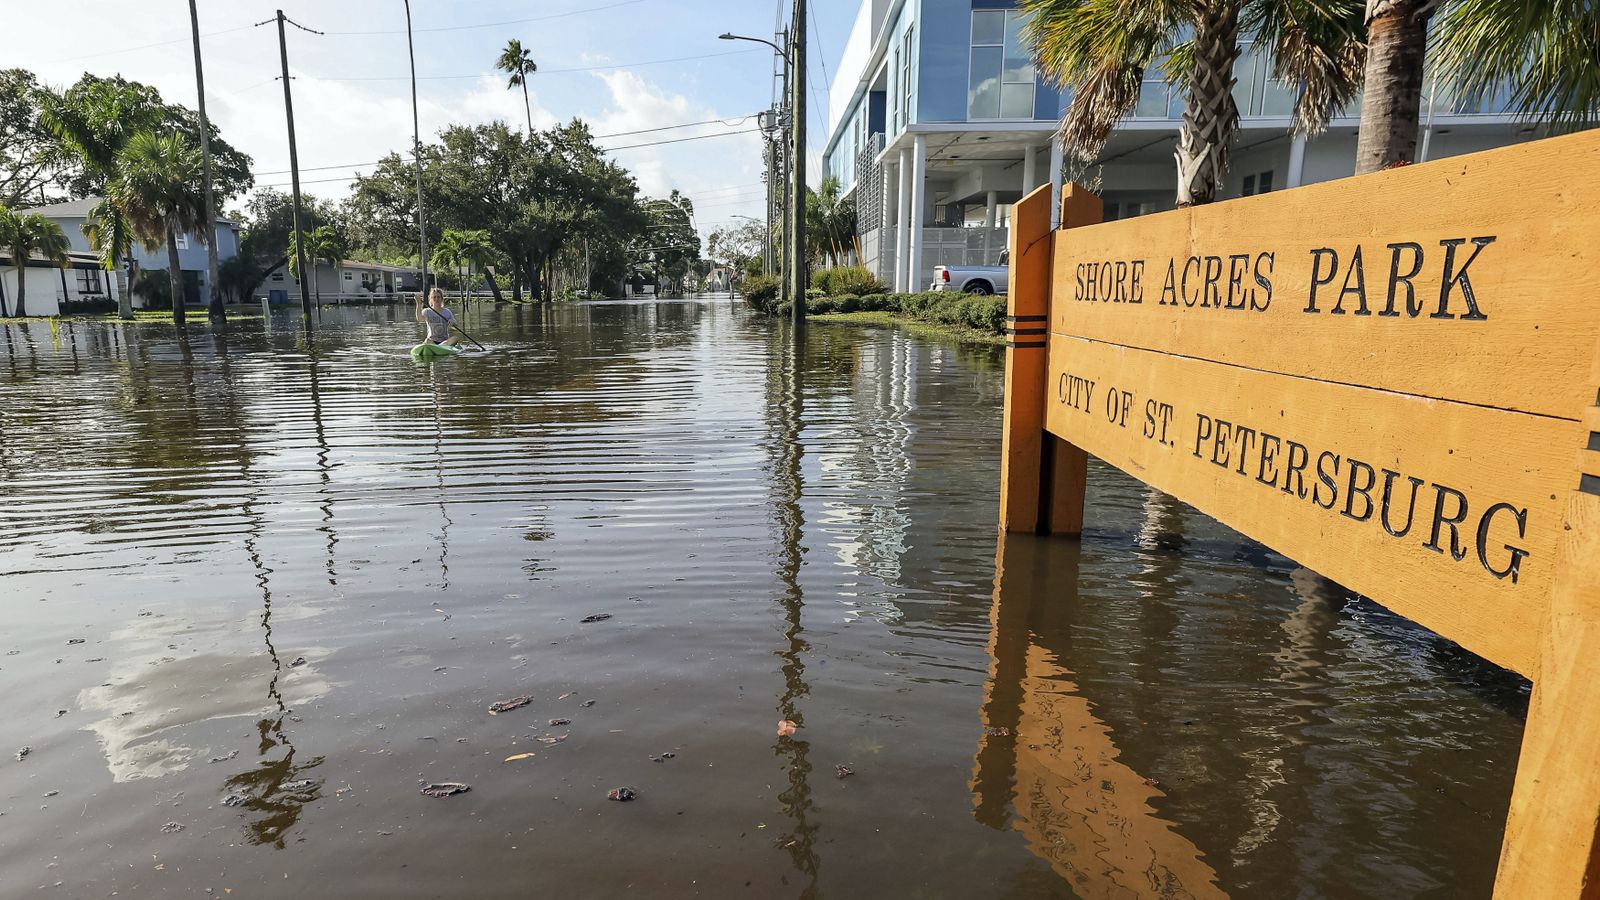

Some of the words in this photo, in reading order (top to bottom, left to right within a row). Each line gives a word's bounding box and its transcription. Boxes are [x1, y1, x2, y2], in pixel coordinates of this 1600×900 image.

[1075, 259, 1145, 305] SHORE
[1159, 251, 1275, 312] ACRES
[1303, 235, 1497, 321] PARK
[1058, 372, 1096, 414] CITY
[1106, 387, 1134, 428] OF
[1143, 399, 1175, 448] ST.
[1193, 413, 1530, 584] PETERSBURG
